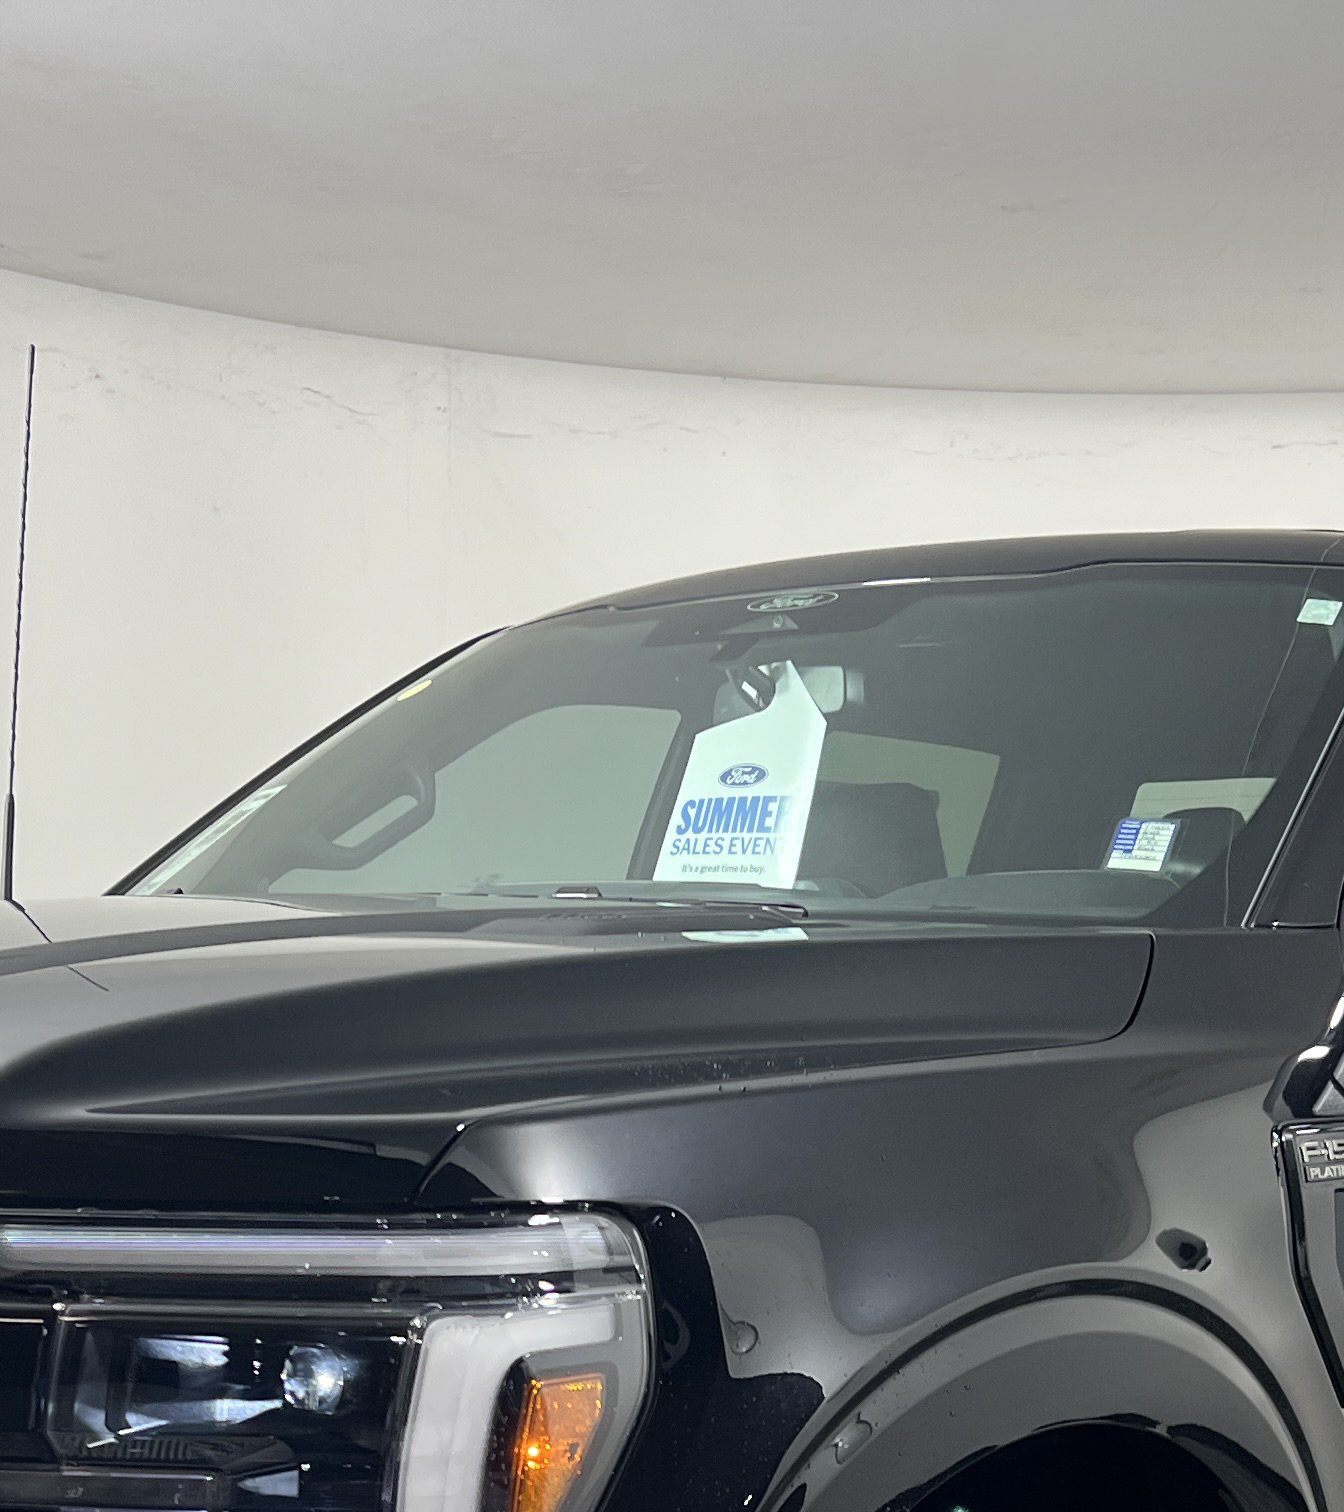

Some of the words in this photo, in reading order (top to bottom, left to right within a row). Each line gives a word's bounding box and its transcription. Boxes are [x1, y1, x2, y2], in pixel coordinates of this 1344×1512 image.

[670, 836, 725, 857] SALES
[727, 836, 784, 855] EVEN
[700, 864, 720, 875] great
[721, 864, 739, 874] time
[740, 864, 749, 874] to
